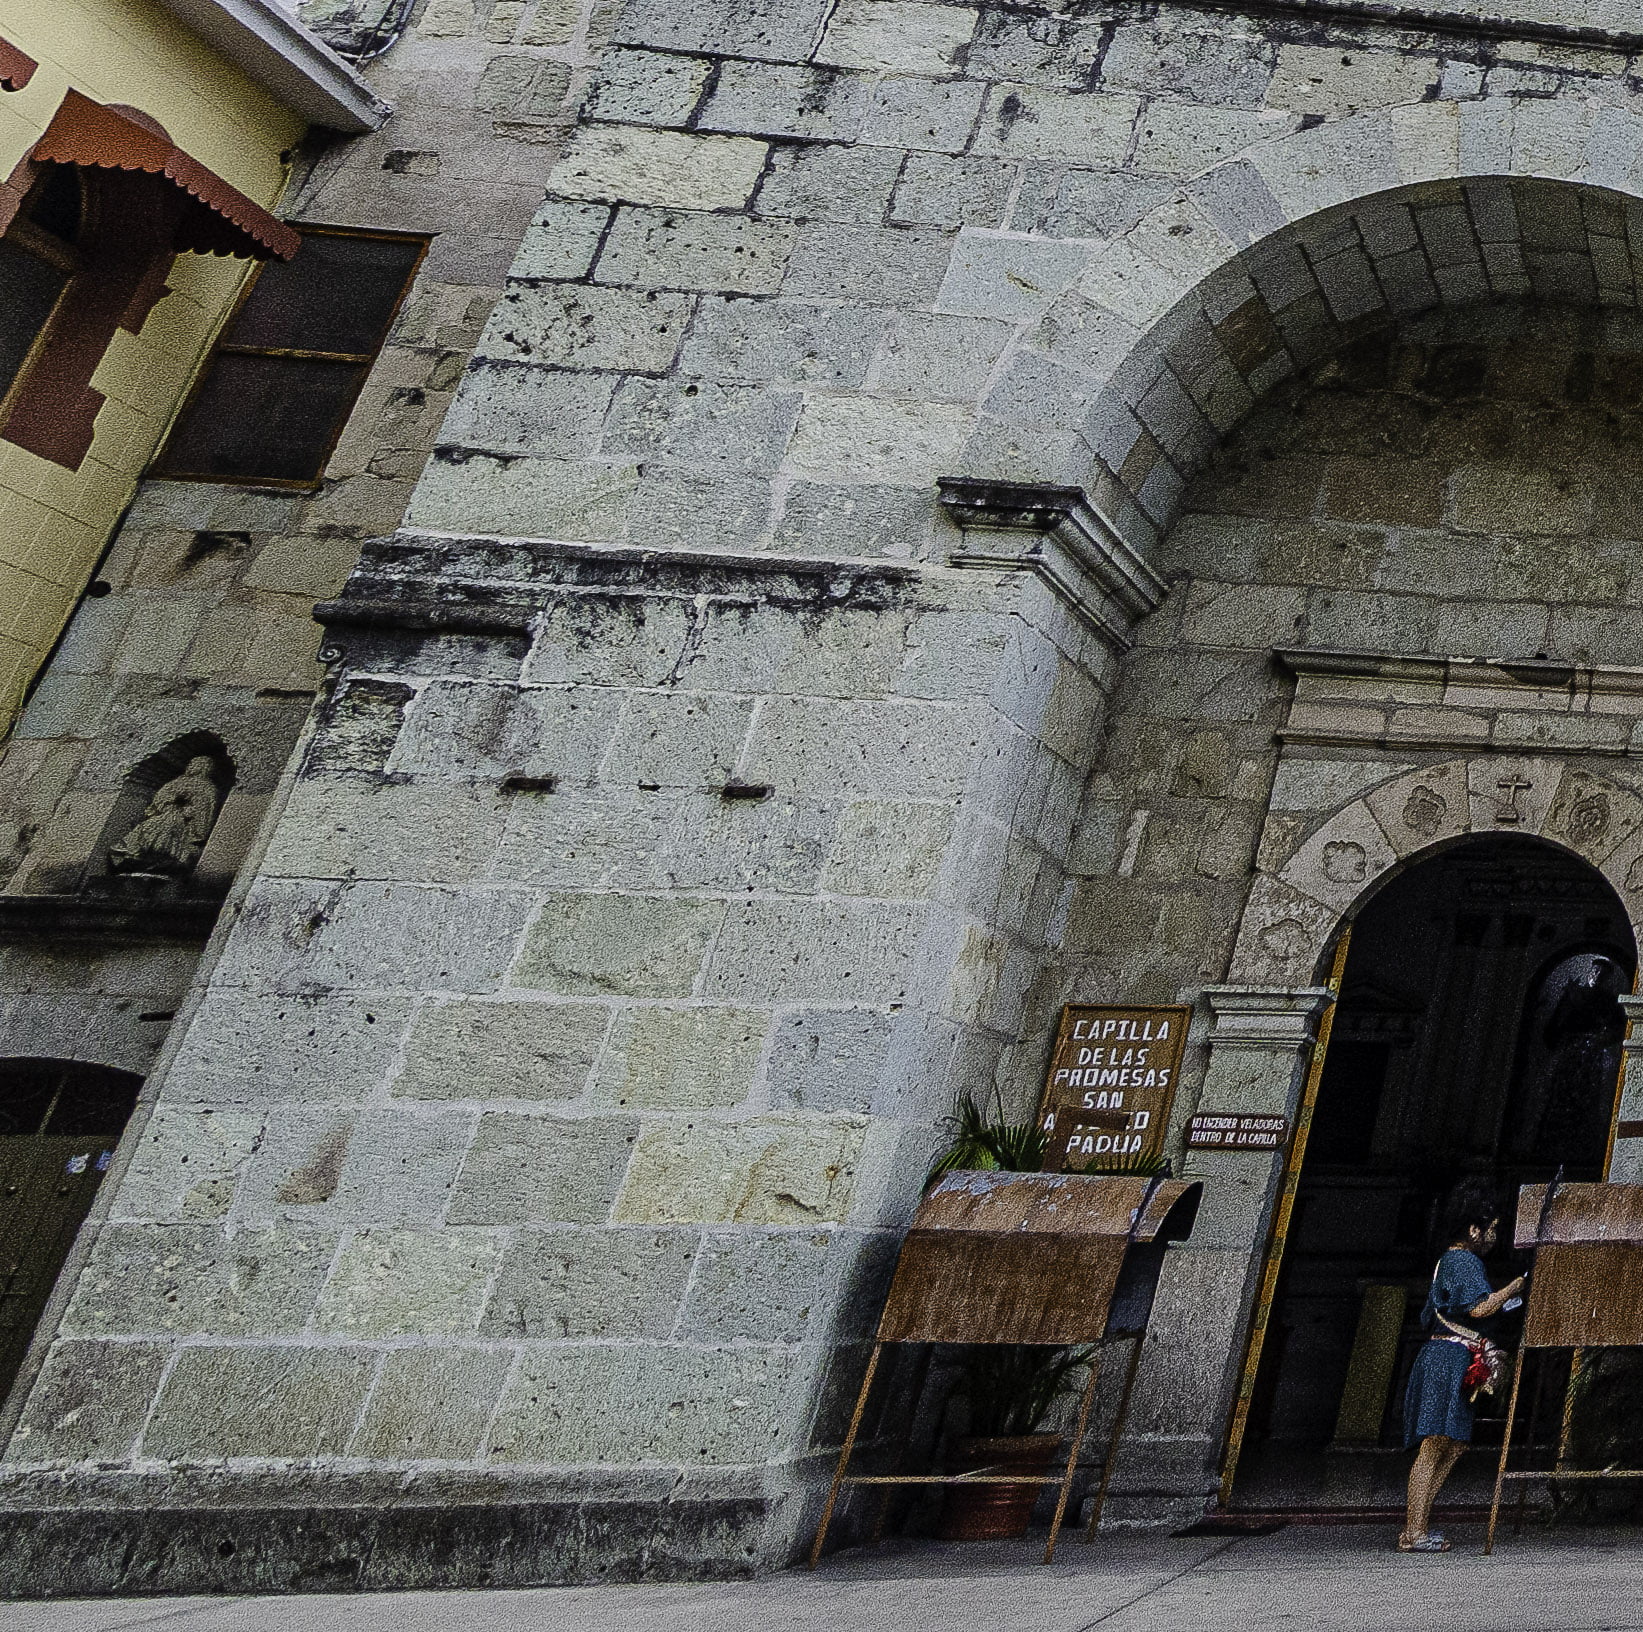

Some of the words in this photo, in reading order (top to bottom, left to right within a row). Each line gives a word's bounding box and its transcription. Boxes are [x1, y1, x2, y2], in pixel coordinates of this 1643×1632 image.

[1073, 1020, 1169, 1040] CAPILLA
[1079, 1048, 1105, 1065] DE
[1109, 1048, 1149, 1065] LAS
[1054, 1069, 1171, 1087] PROMESAS
[1083, 1091, 1123, 1108] SAN
[1066, 1135, 1142, 1154] PADUA
[1225, 1132, 1236, 1143] DE
[1237, 1132, 1247, 1144] LA
